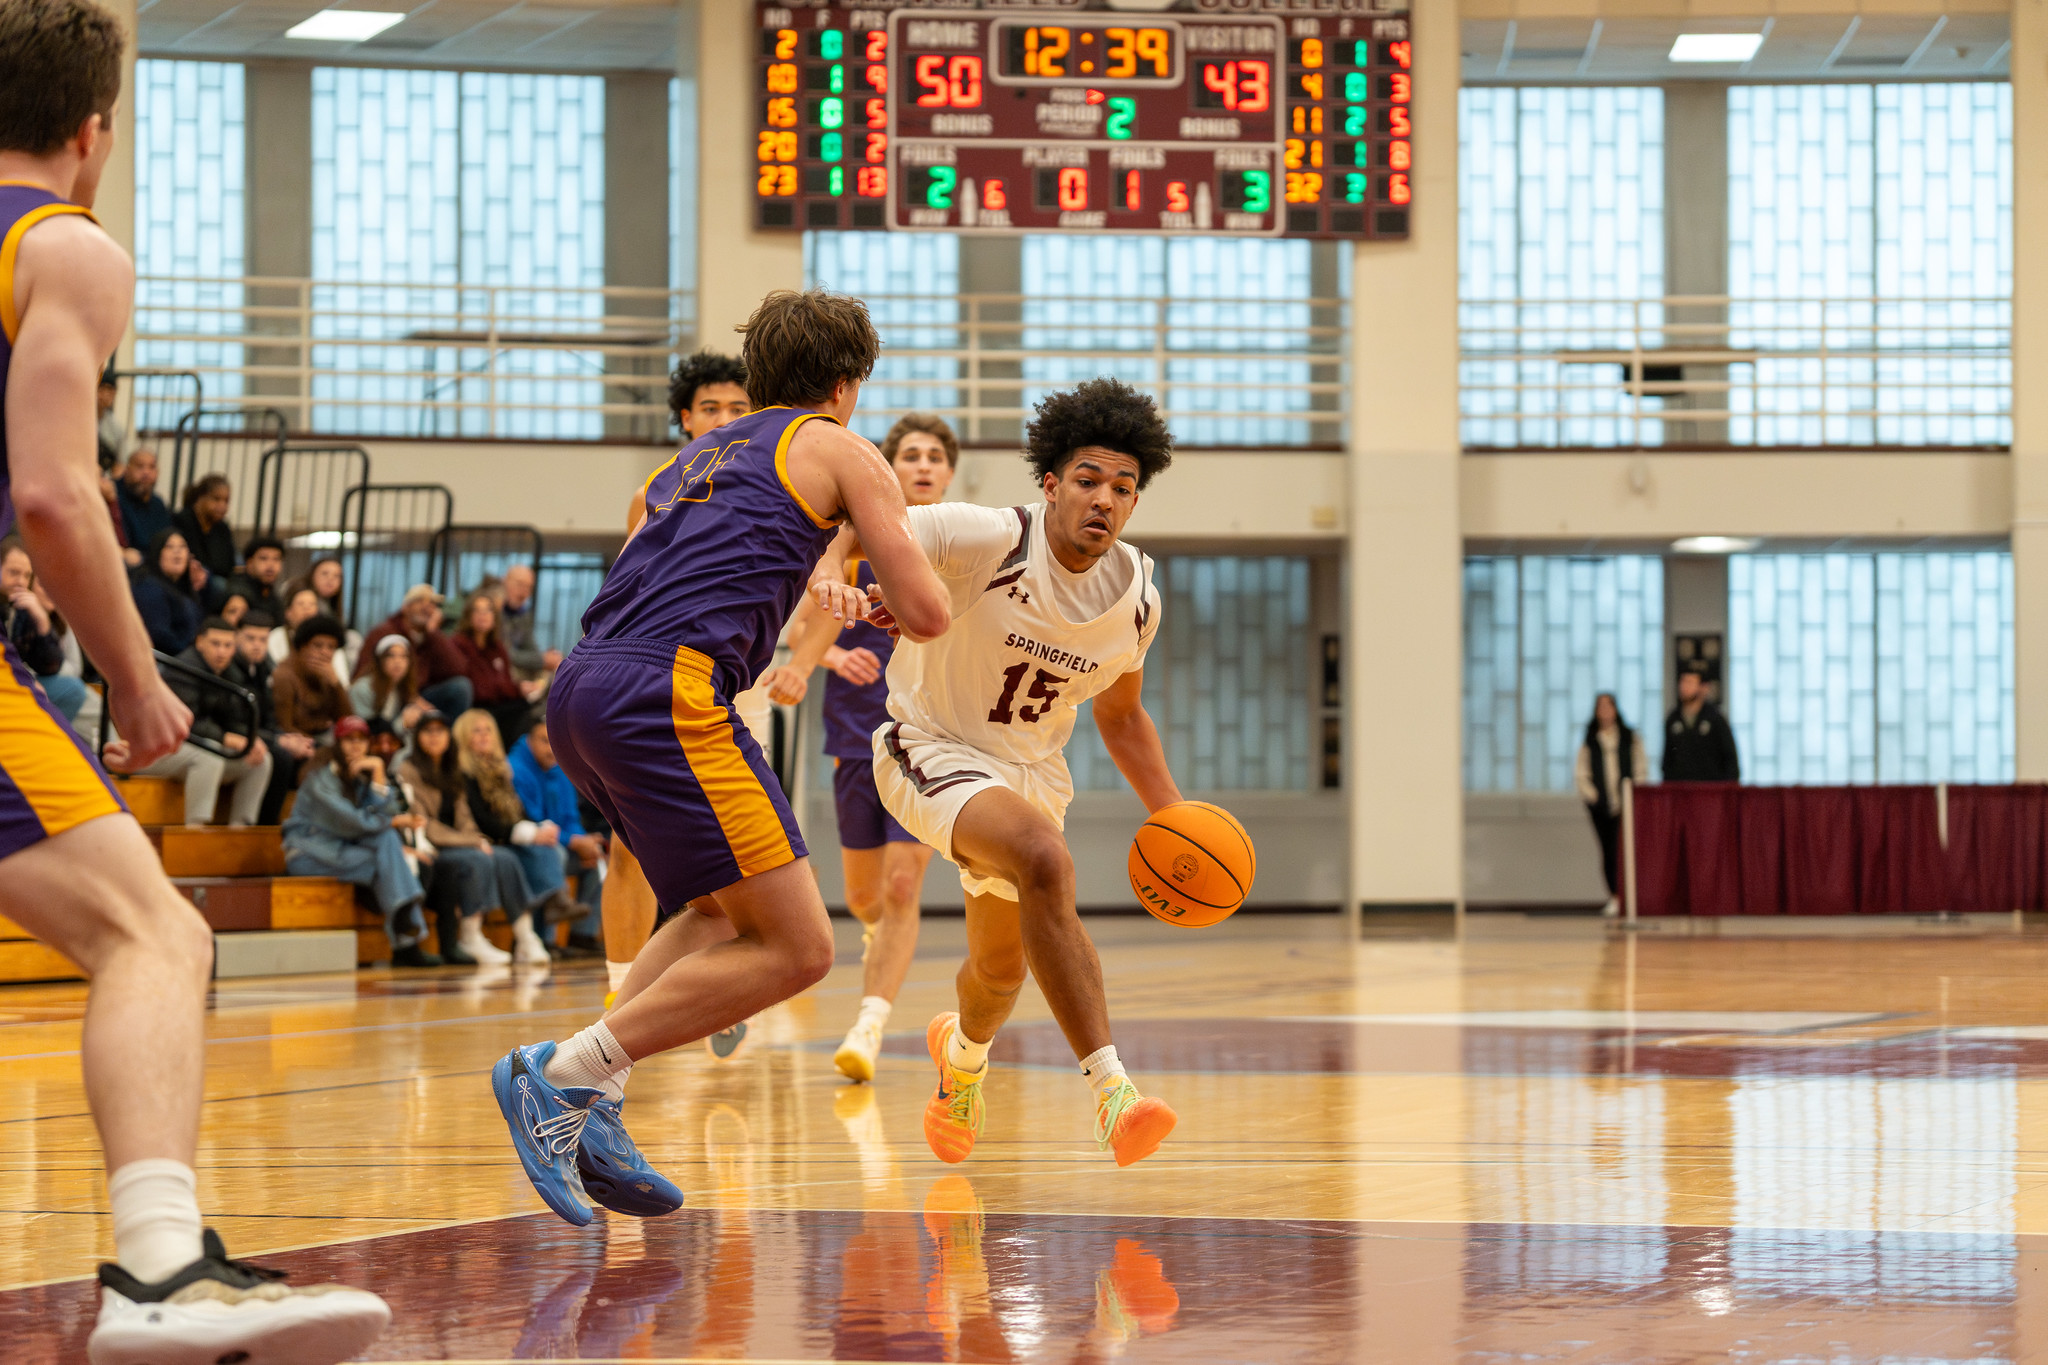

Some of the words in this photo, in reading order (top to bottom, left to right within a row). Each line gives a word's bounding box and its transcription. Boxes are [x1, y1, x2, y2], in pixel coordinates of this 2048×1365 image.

[775, 29, 798, 60] 2
[865, 30, 888, 61] 2
[907, 21, 978, 47] HOME
[1187, 26, 1274, 51] VISITOR
[1024, 25, 1169, 79] 12:39
[1354, 39, 1367, 69] 1
[1389, 40, 1411, 69] 4
[829, 64, 844, 94] 1
[865, 64, 888, 94] 9
[916, 54, 982, 108] 50
[1203, 60, 1270, 112] 43
[1301, 72, 1323, 101] 4
[1389, 73, 1411, 104] 3
[767, 97, 798, 127] 15
[865, 98, 888, 129] 5
[1107, 97, 1136, 140] 2
[1293, 106, 1323, 134] 11
[1345, 105, 1367, 136] 2
[1389, 106, 1411, 137] 5
[865, 132, 888, 163] 2
[1283, 138, 1323, 169] 21
[1354, 140, 1367, 169] 1
[757, 164, 798, 196] 23
[829, 165, 844, 197] 1
[857, 166, 888, 197] 13
[927, 165, 957, 209] 2
[983, 178, 1006, 211] 6
[1058, 167, 1088, 211] 0
[1126, 169, 1141, 211] 1
[1166, 181, 1189, 213] 5
[1241, 170, 1270, 213] 3
[1284, 172, 1323, 204] 32
[1345, 172, 1367, 204] 3
[1389, 173, 1411, 205] 6
[1004, 632, 1099, 675] SPRINGFIELD
[988, 661, 1071, 725] 15
[1141, 885, 1187, 918] EVO
